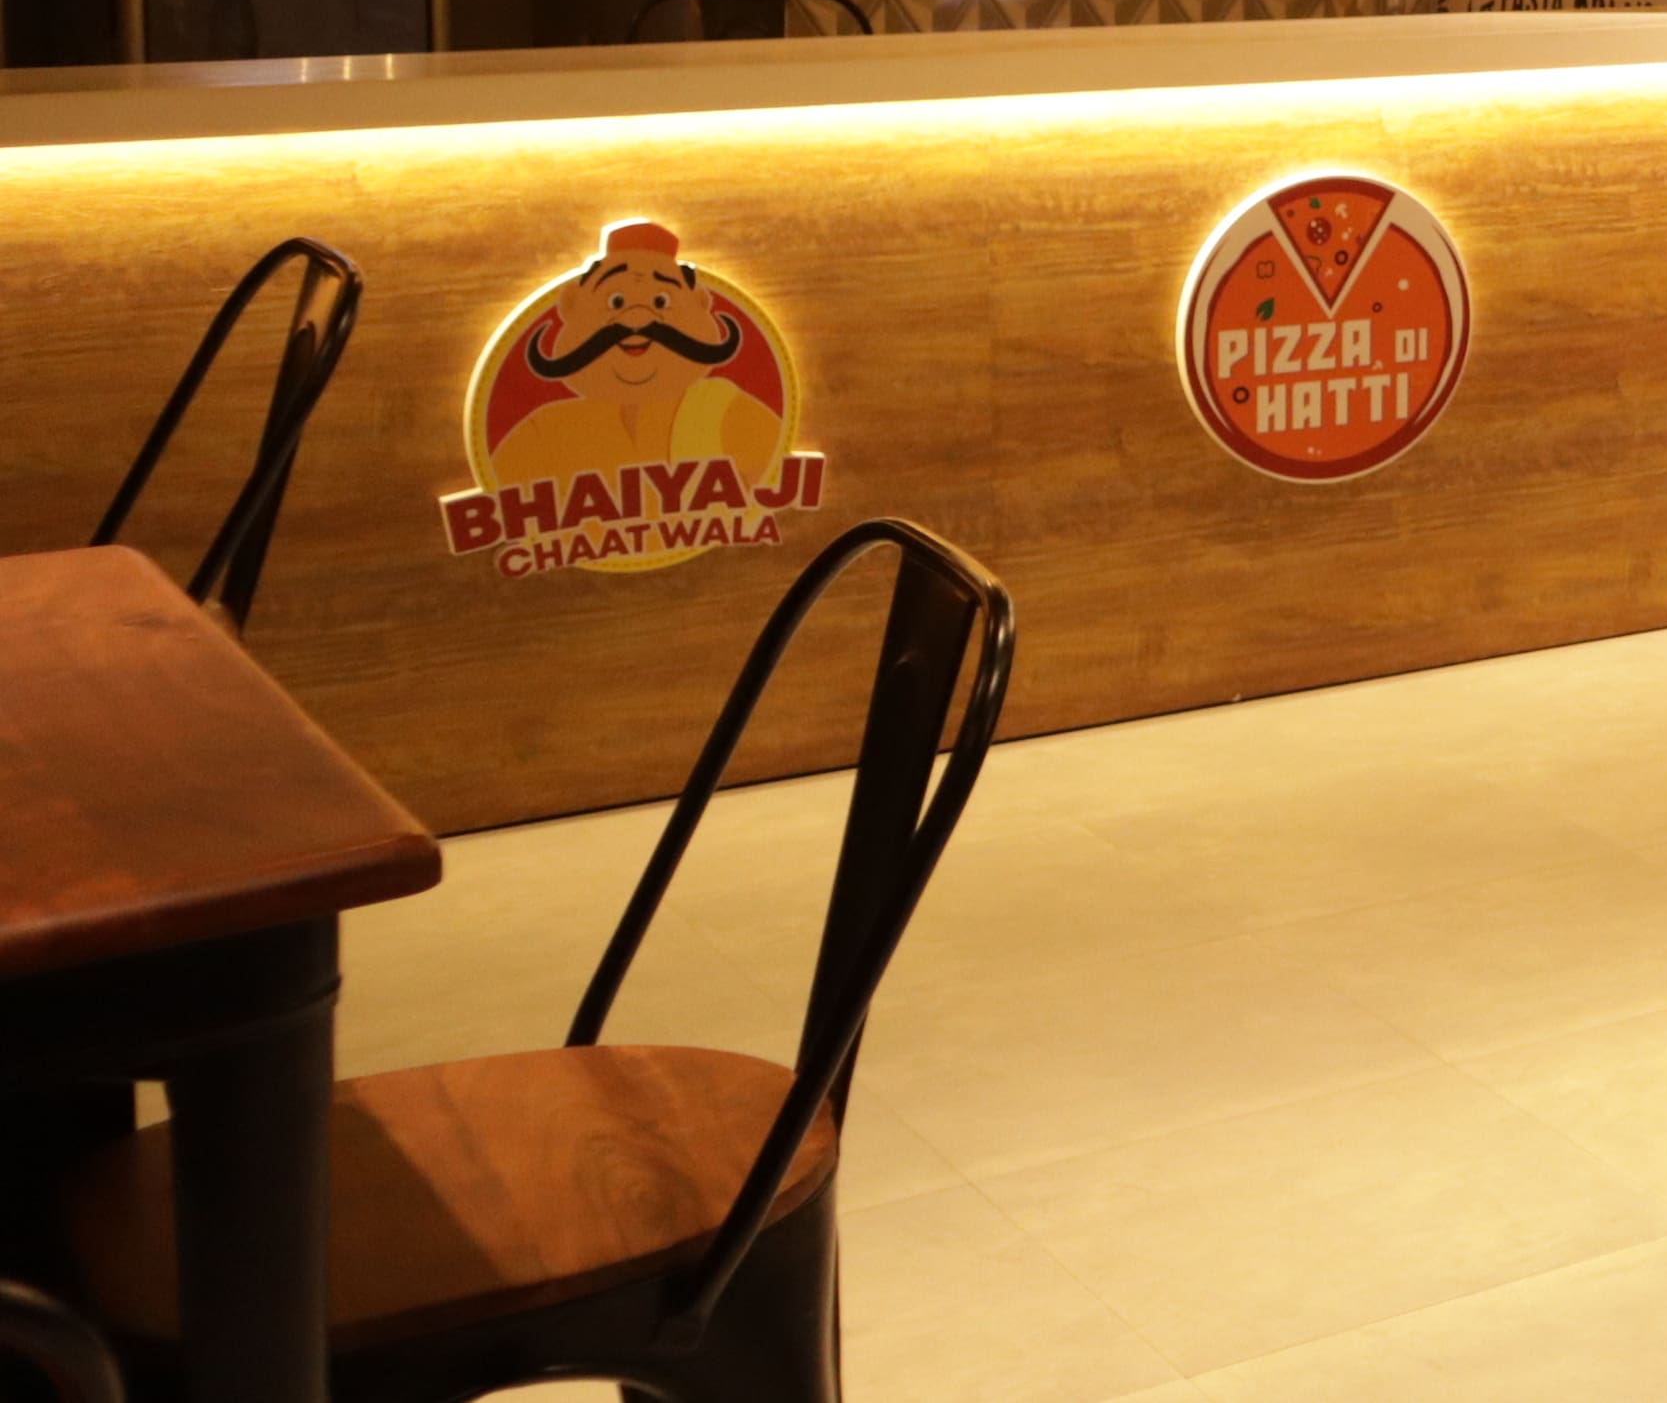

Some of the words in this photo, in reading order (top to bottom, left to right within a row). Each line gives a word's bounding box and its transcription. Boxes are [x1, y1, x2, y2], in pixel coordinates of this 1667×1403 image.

[1216, 320, 1374, 380] PIZZA
[1394, 328, 1428, 364] DI
[1254, 373, 1410, 433] HATTI
[444, 459, 746, 554] BHAIYA
[754, 457, 824, 509] JI
[498, 524, 651, 578] CHAAT
[658, 513, 781, 552] WALA
